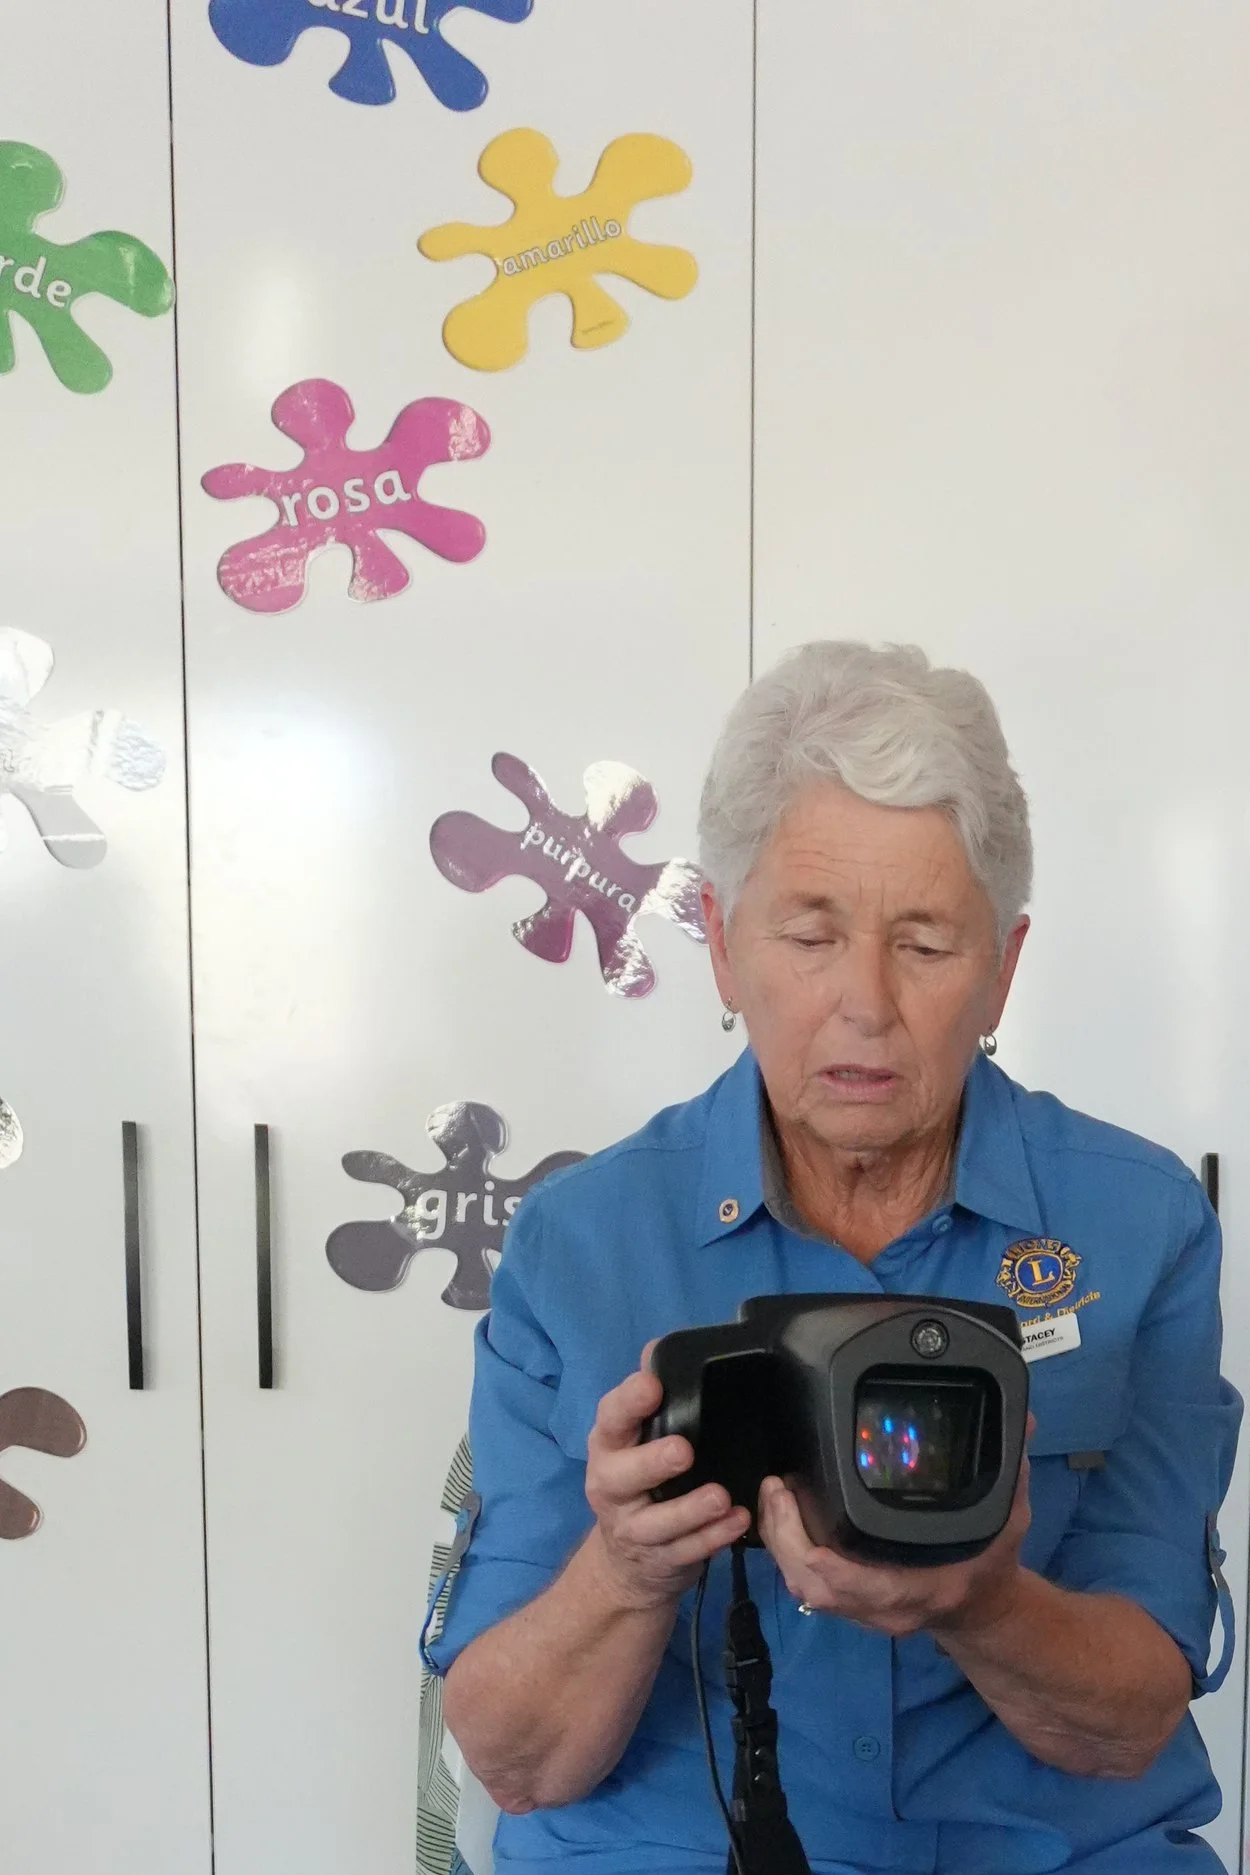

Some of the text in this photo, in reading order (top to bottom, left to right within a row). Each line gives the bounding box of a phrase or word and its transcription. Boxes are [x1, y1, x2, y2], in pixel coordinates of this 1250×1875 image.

[502, 215, 622, 276] amarillo
[282, 469, 412, 526] rosa
[1027, 1258, 1055, 1286] L
